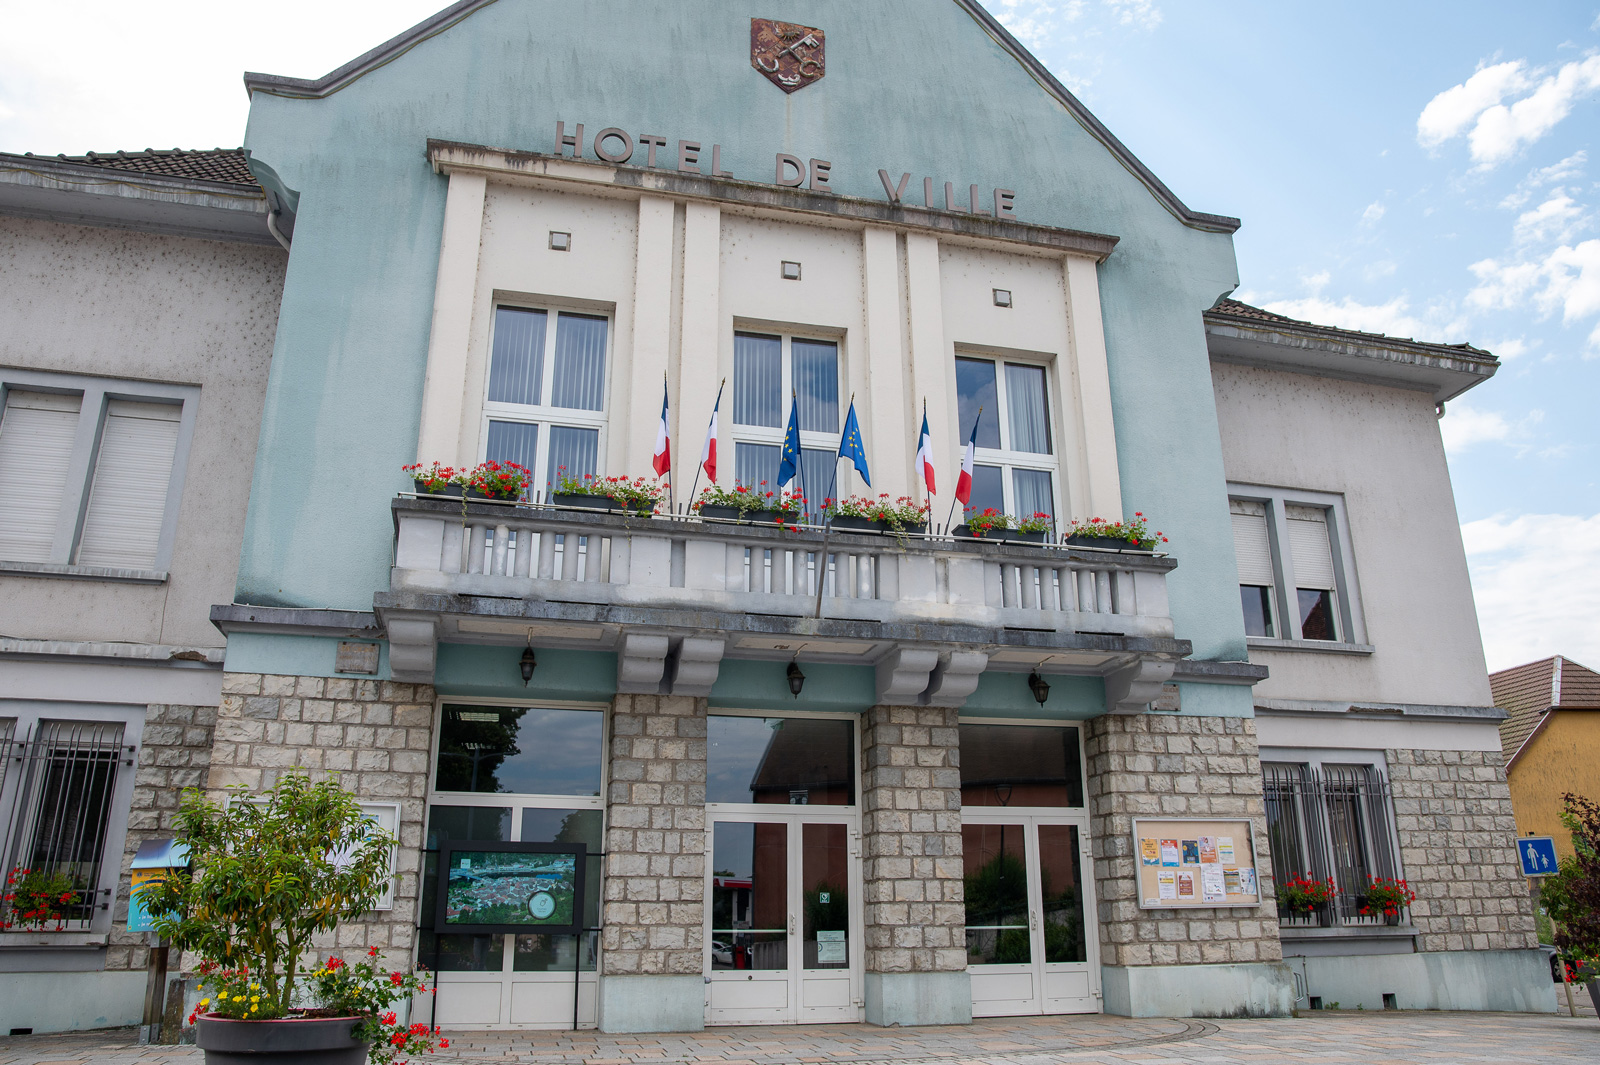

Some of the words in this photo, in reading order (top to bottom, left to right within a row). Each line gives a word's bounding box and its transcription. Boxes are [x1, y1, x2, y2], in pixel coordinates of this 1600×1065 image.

[554, 120, 733, 179] HOTEL
[775, 152, 832, 193] DE
[878, 169, 1017, 221] VILLE
